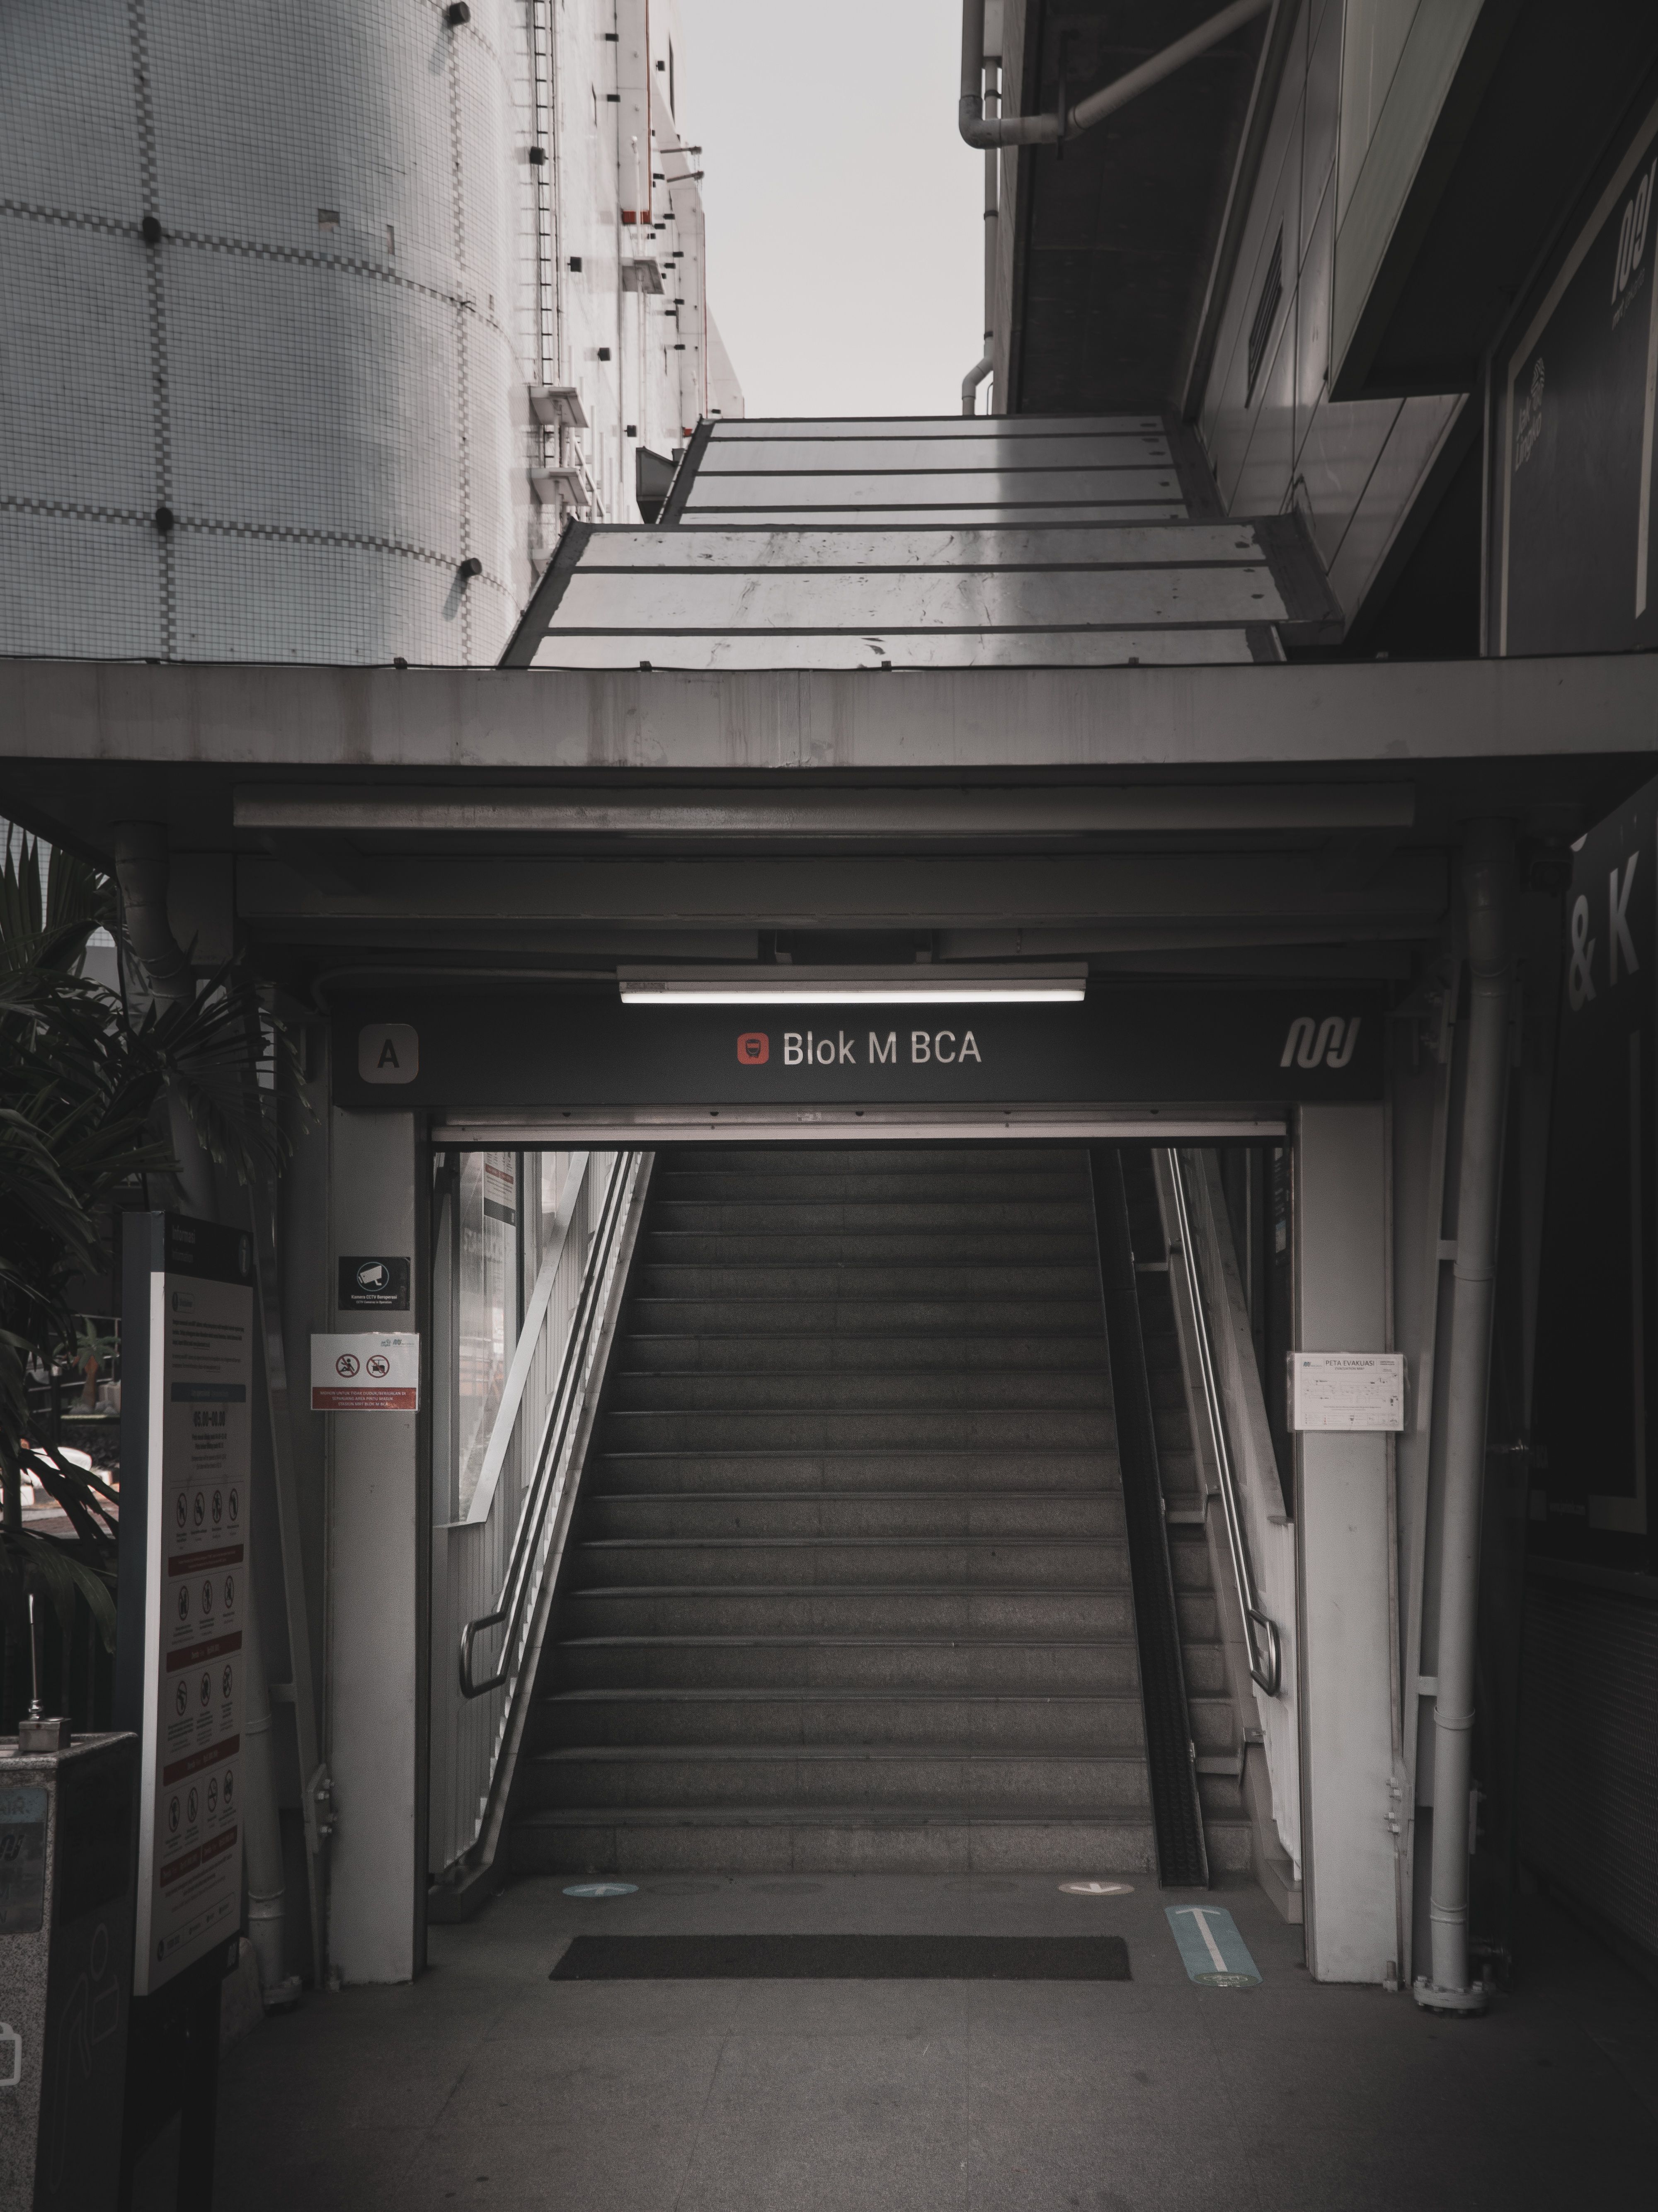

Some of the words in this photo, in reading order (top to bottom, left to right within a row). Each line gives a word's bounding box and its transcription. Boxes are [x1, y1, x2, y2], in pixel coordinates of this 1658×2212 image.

[377, 1039, 400, 1068] A
[783, 1030, 857, 1065] Blok
[868, 1031, 897, 1064] M
[911, 1030, 982, 1063] BCA
[172, 1224, 196, 1244] Informasi
